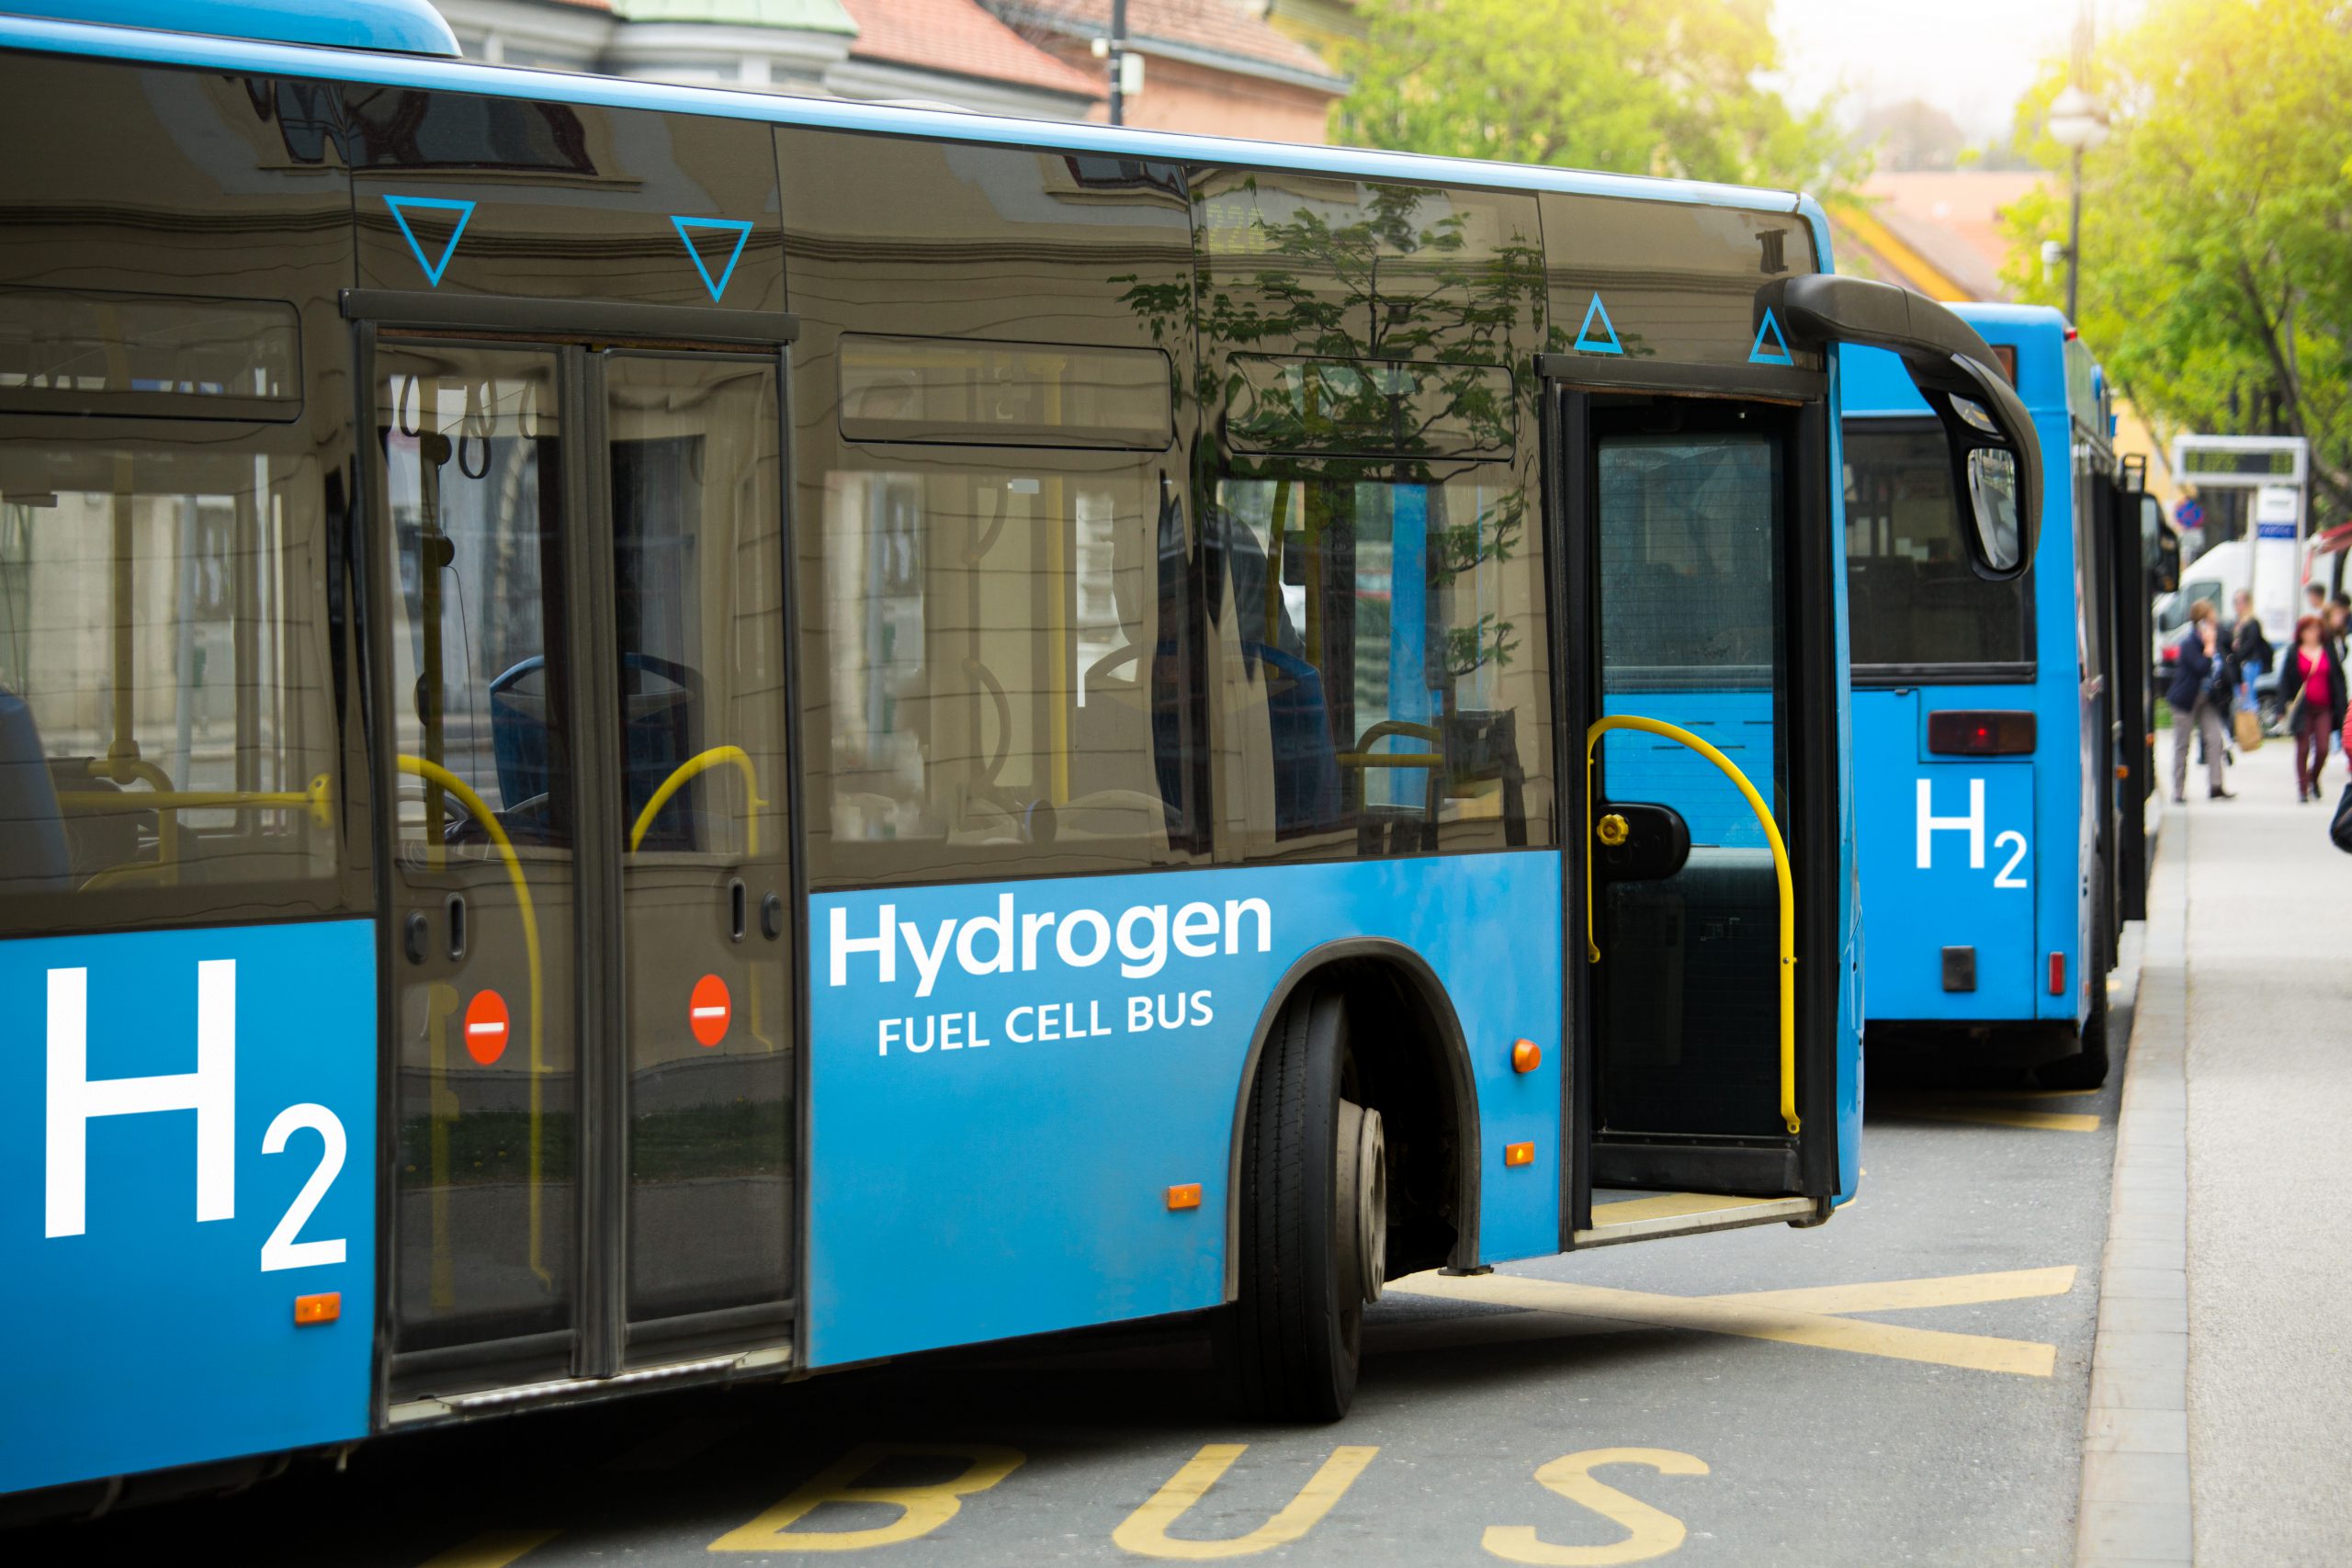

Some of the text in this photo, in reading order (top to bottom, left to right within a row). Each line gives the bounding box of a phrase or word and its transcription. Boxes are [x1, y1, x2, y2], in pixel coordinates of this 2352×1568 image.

[1917, 779, 2027, 888] H2
[830, 893, 1272, 998] Hydrogen
[878, 989, 1214, 1056] FUEL CELL BUS
[46, 959, 347, 1272] H2
[707, 1443, 1711, 1567] BUS
